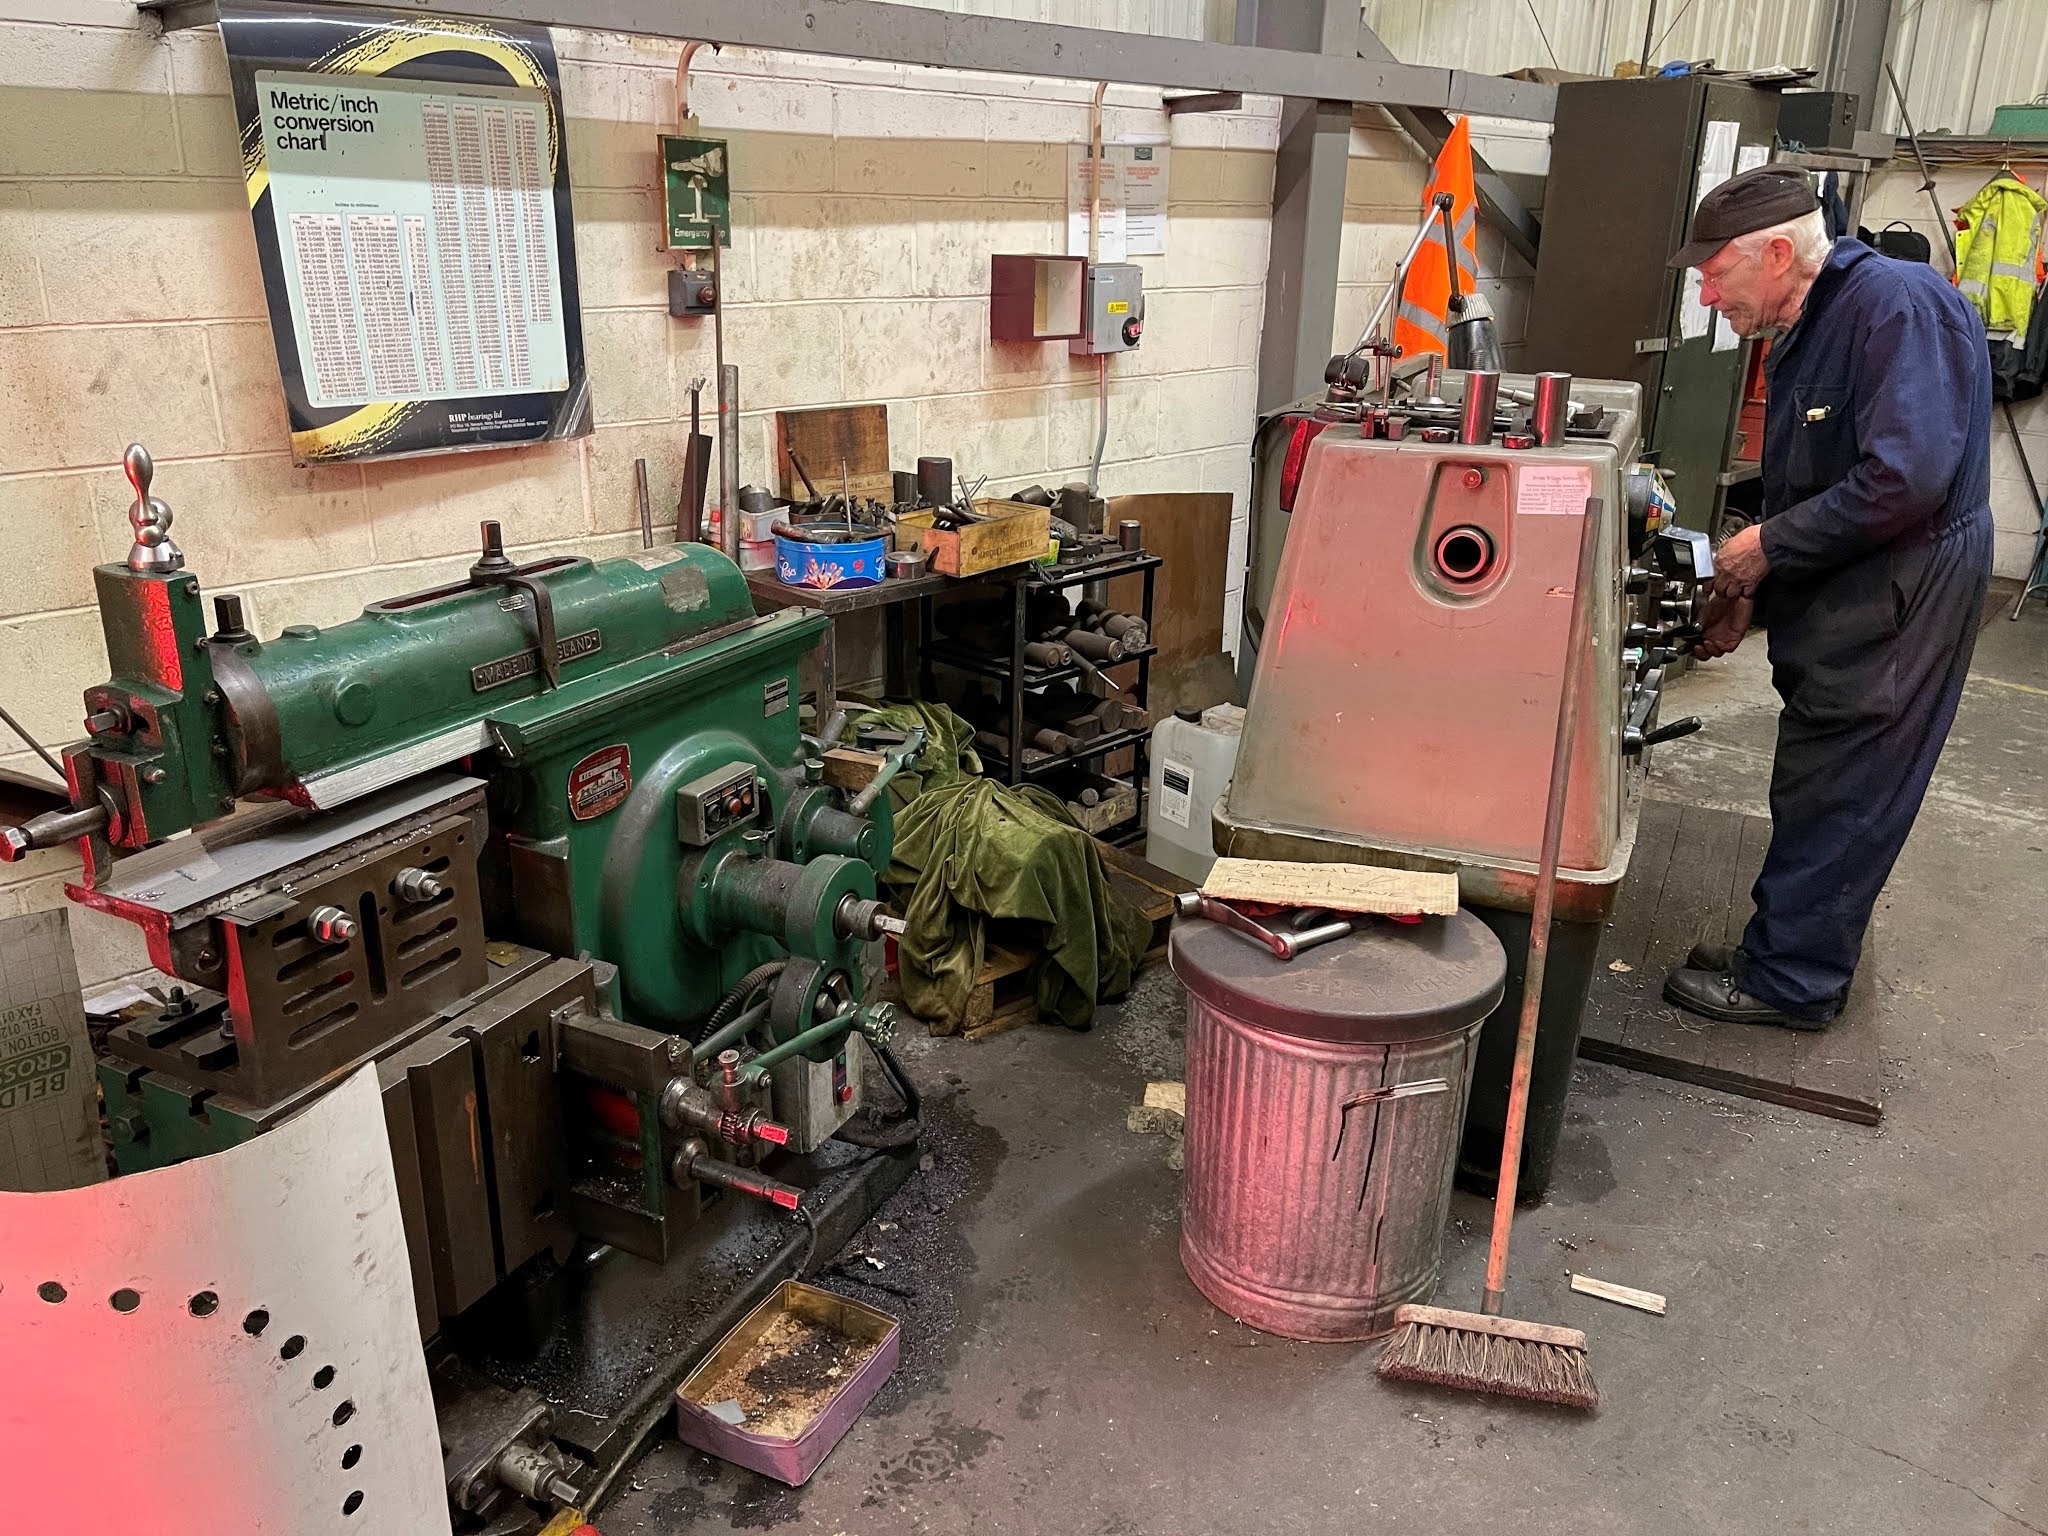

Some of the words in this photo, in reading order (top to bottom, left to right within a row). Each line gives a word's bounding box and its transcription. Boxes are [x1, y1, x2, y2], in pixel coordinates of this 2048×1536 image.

[270, 91, 379, 114] Metric/inch
[273, 114, 375, 133] conversion
[276, 131, 328, 151] chart
[674, 227, 710, 239] Emergency
[449, 413, 467, 423] RHP
[779, 562, 797, 580] Roses
[482, 658, 519, 684] MADE
[523, 653, 536, 671] IN
[556, 635, 593, 659] GLAND
[17, 1002, 42, 1020] FAX
[22, 1016, 46, 1031] TEL
[0, 1049, 67, 1085] CROS
